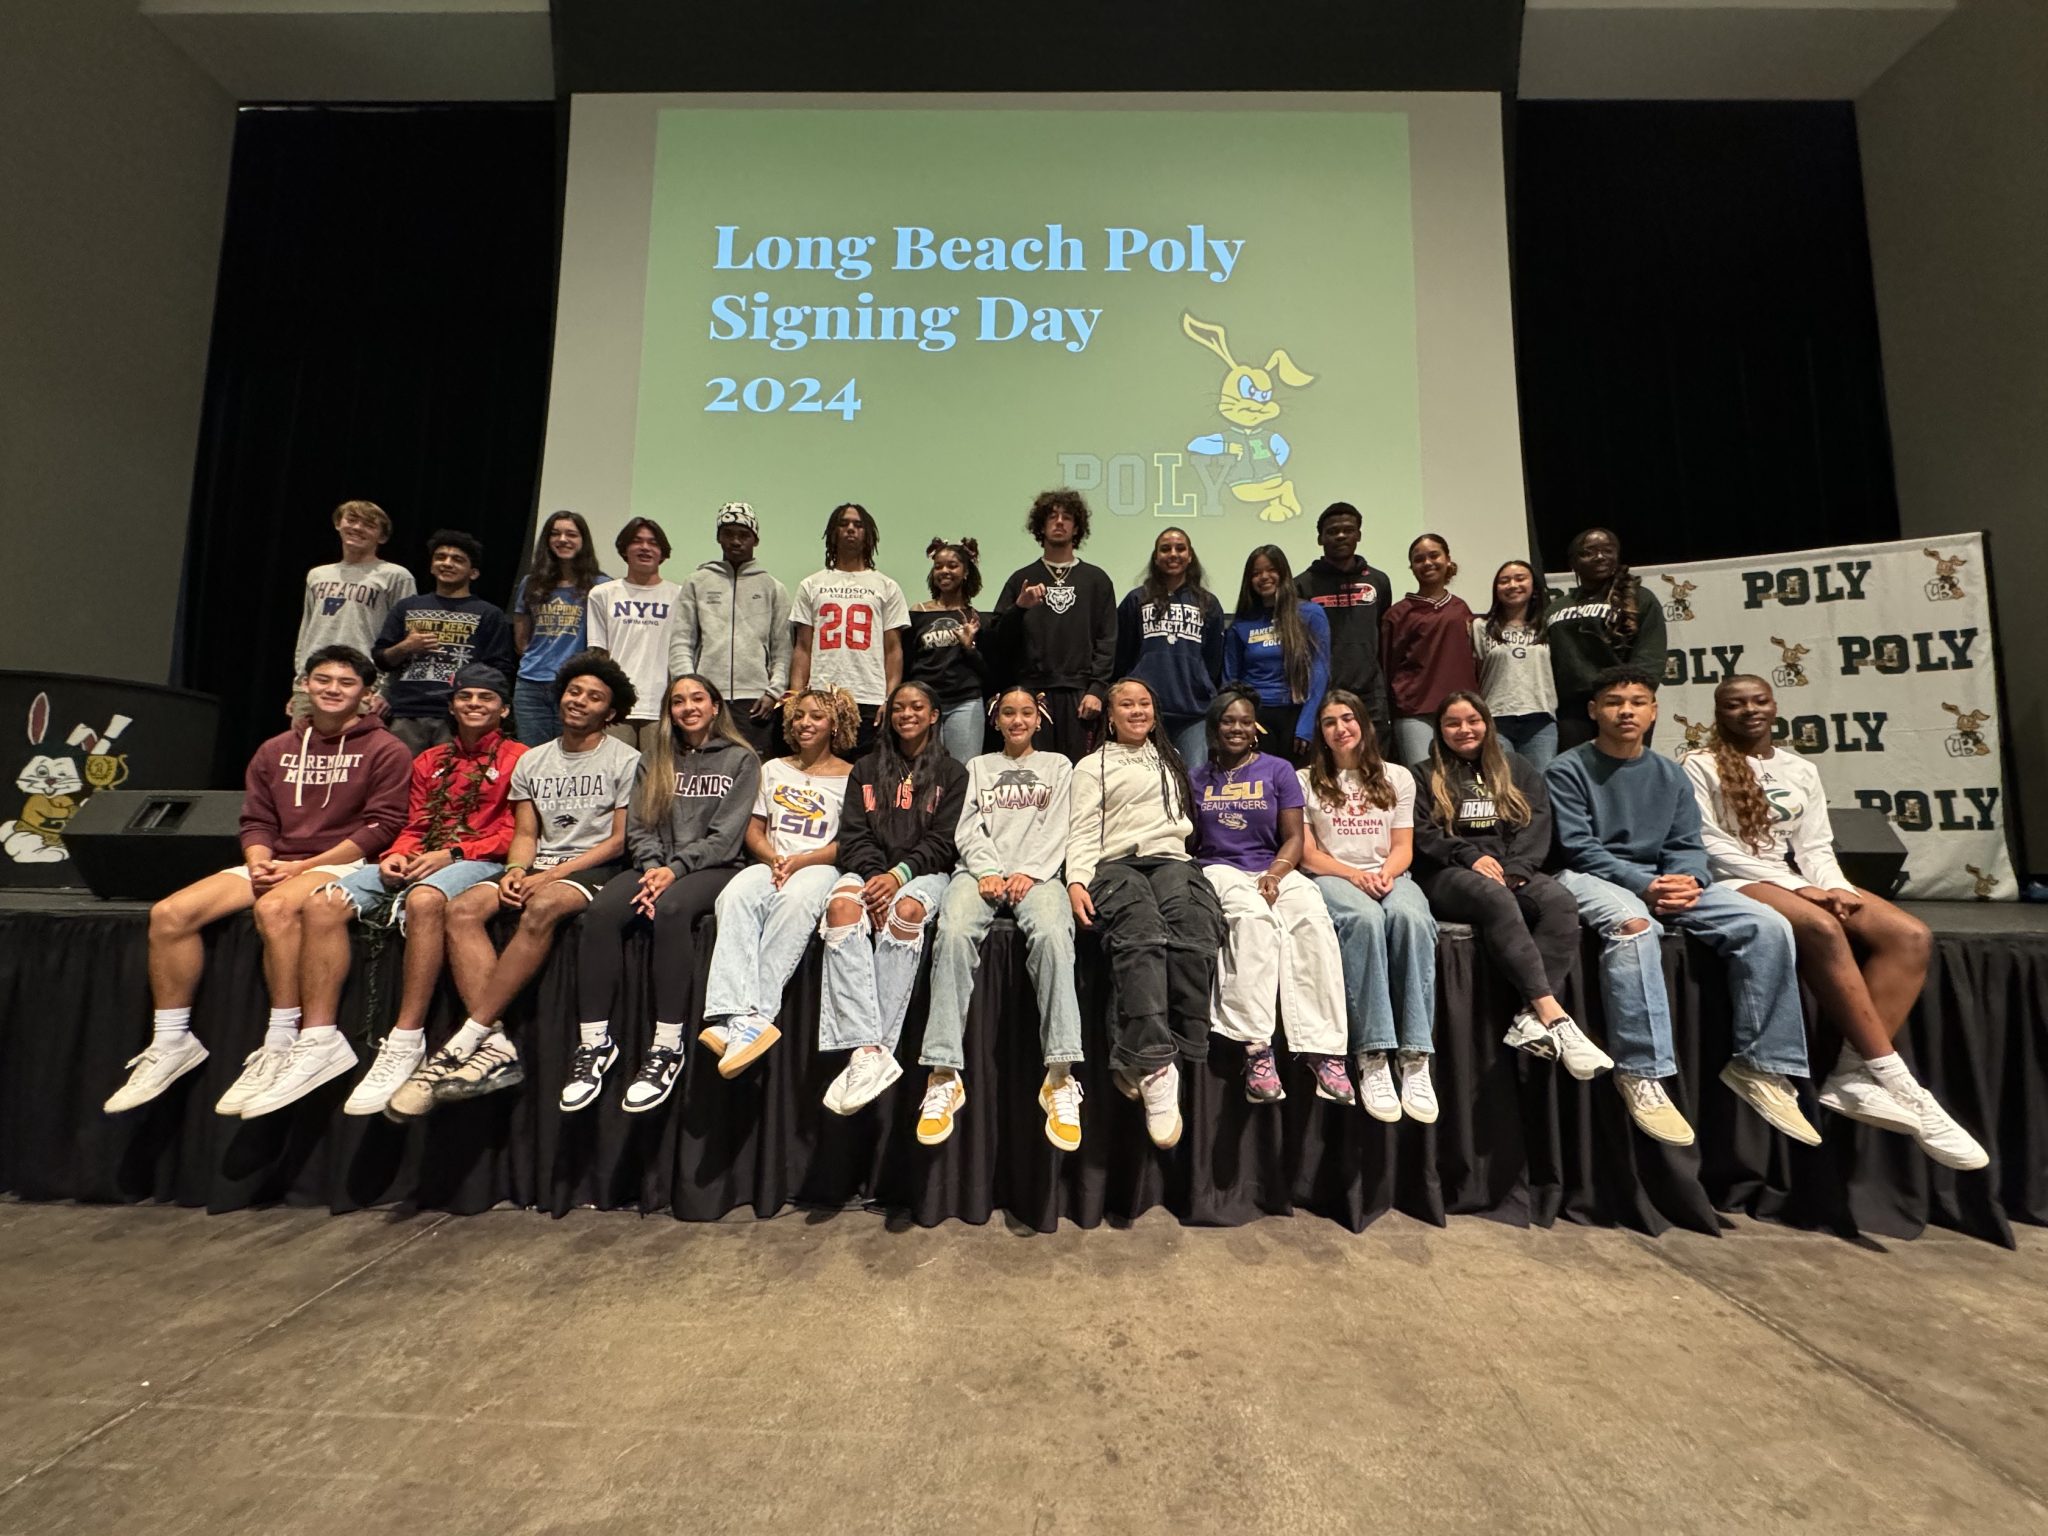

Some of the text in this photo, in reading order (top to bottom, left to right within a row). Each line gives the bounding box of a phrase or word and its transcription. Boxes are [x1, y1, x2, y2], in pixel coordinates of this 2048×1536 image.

[713, 224, 1245, 282] Long Beach Poly
[710, 292, 1102, 352] Signing Day
[704, 377, 861, 420] 2024
[1057, 453, 1238, 516] POLY
[820, 587, 875, 596] DAVIDSON
[1742, 561, 1871, 609] POLY
[614, 601, 669, 619] NYU
[442, 621, 477, 635] MERCY
[819, 603, 873, 651] 28
[1512, 647, 1527, 659] G
[1838, 627, 1978, 675] POLY
[1661, 645, 1744, 686] OLY
[280, 753, 363, 769] CLREMONT
[529, 775, 603, 798] NEVADA
[981, 783, 1052, 813] PVAMU
[1204, 781, 1263, 801] LSU
[1201, 800, 1268, 811] GEAUX TIGERS
[769, 813, 828, 838] LSU
[1337, 827, 1380, 835] COLLEGE
[1470, 820, 1496, 828] RUGBY
